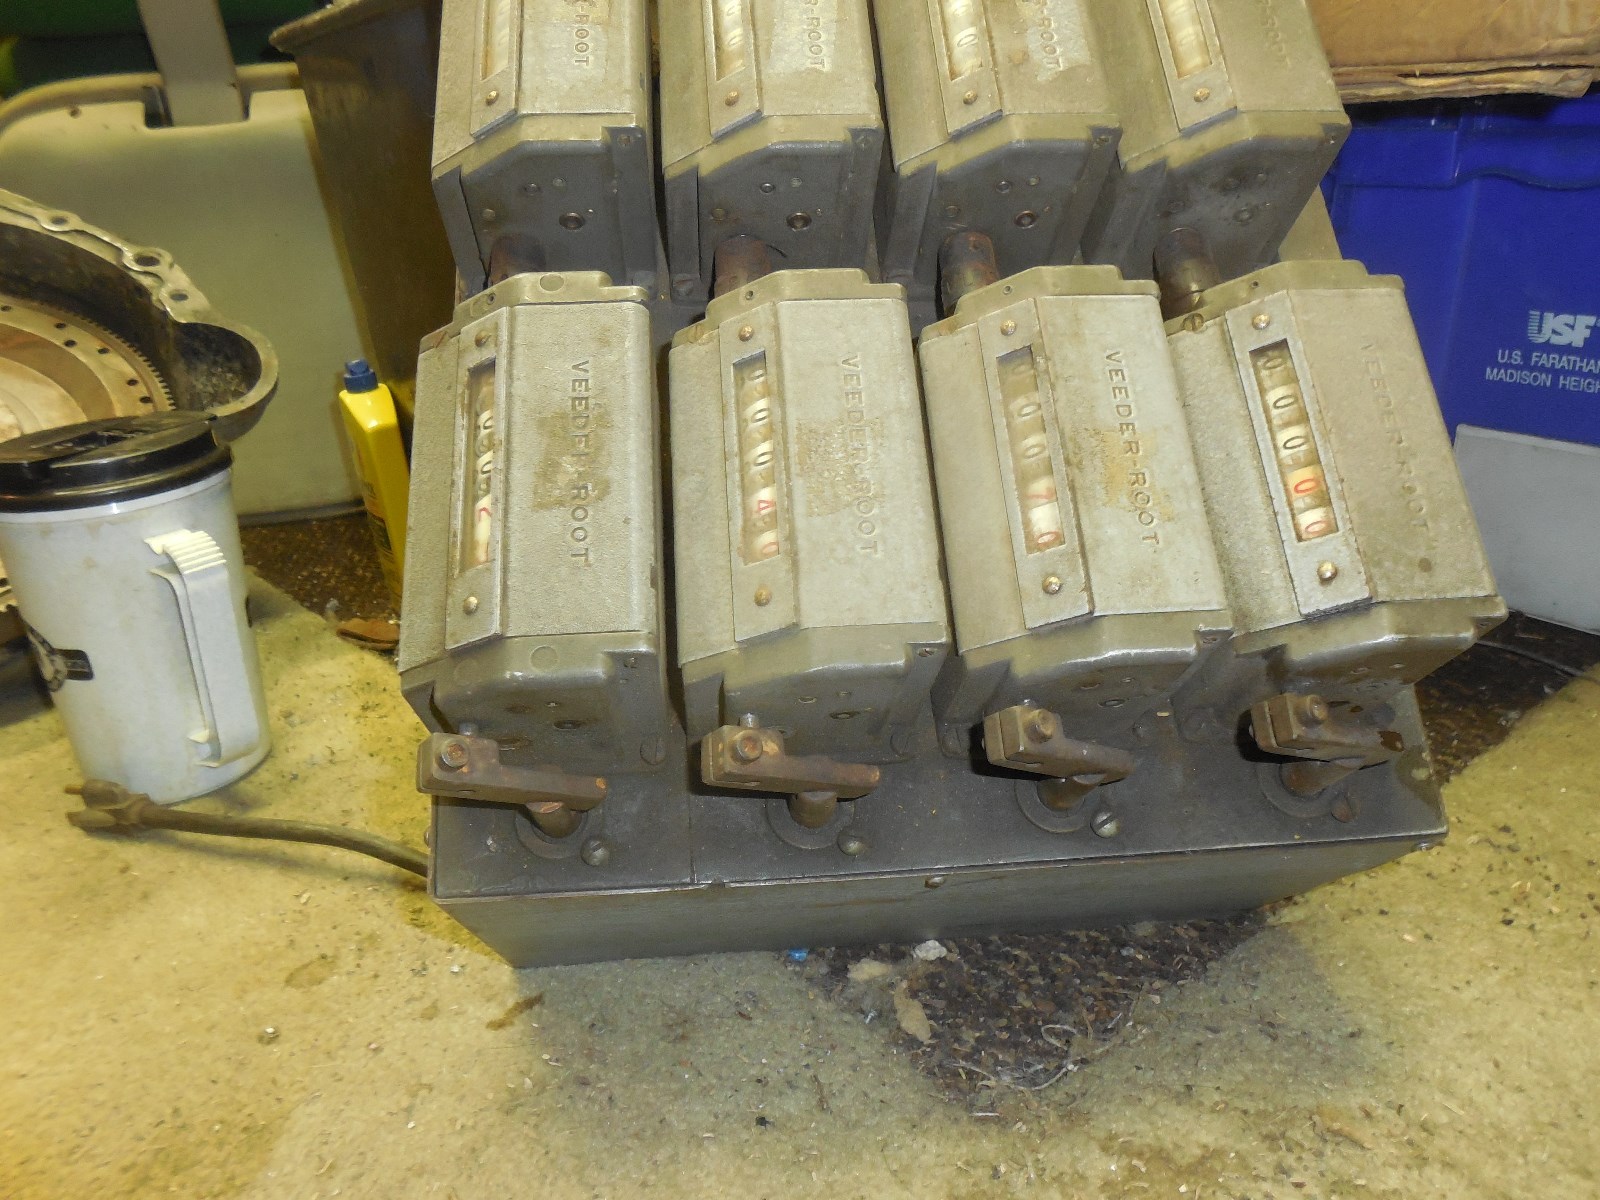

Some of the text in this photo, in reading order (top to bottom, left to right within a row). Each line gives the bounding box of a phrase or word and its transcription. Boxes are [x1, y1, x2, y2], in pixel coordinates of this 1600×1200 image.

[1527, 310, 1597, 348] USF
[1497, 349, 1524, 365] U.S.
[1485, 367, 1552, 388] MADISON
[1105, 350, 1160, 546] VEEDER-ROOT
